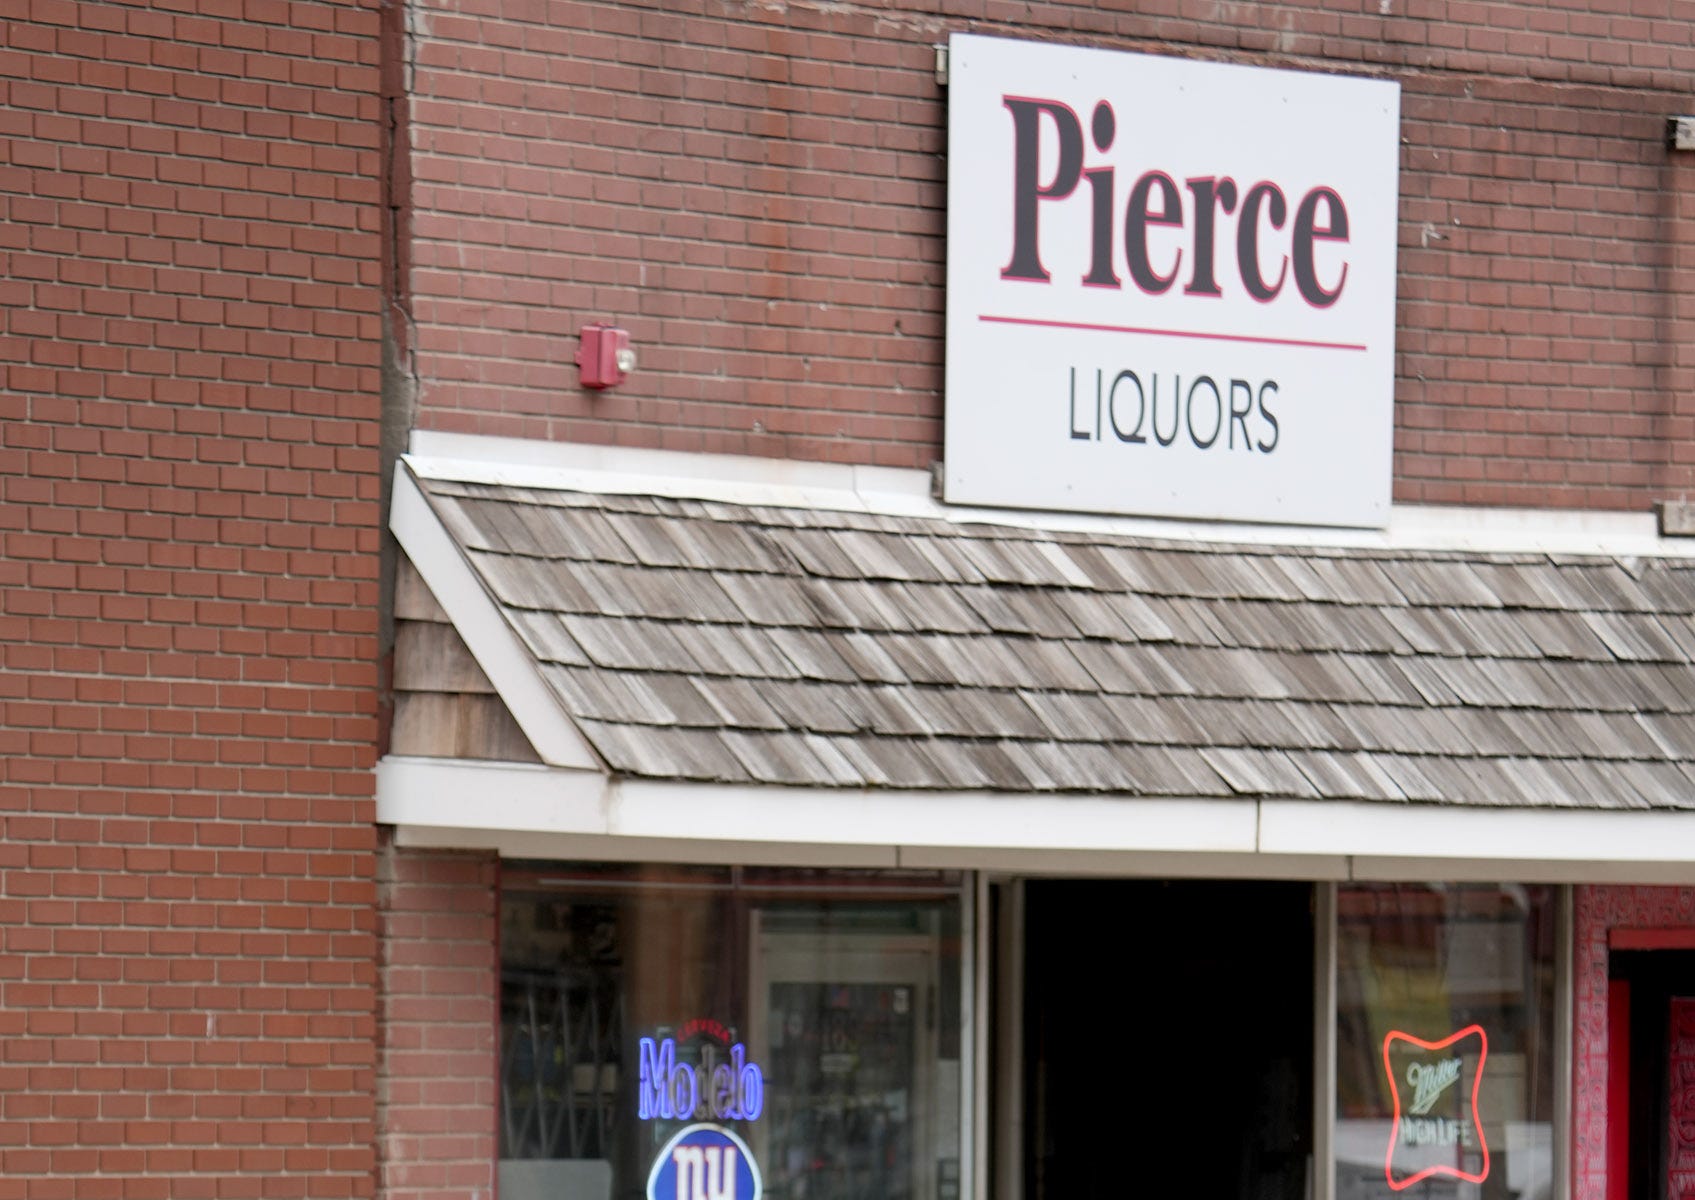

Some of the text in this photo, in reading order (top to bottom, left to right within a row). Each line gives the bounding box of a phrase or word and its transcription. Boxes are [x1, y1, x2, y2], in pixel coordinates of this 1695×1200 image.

[1000, 94, 1350, 309] Pierce
[1070, 366, 1280, 455] LIQUORS
[638, 1036, 764, 1121] Modelo
